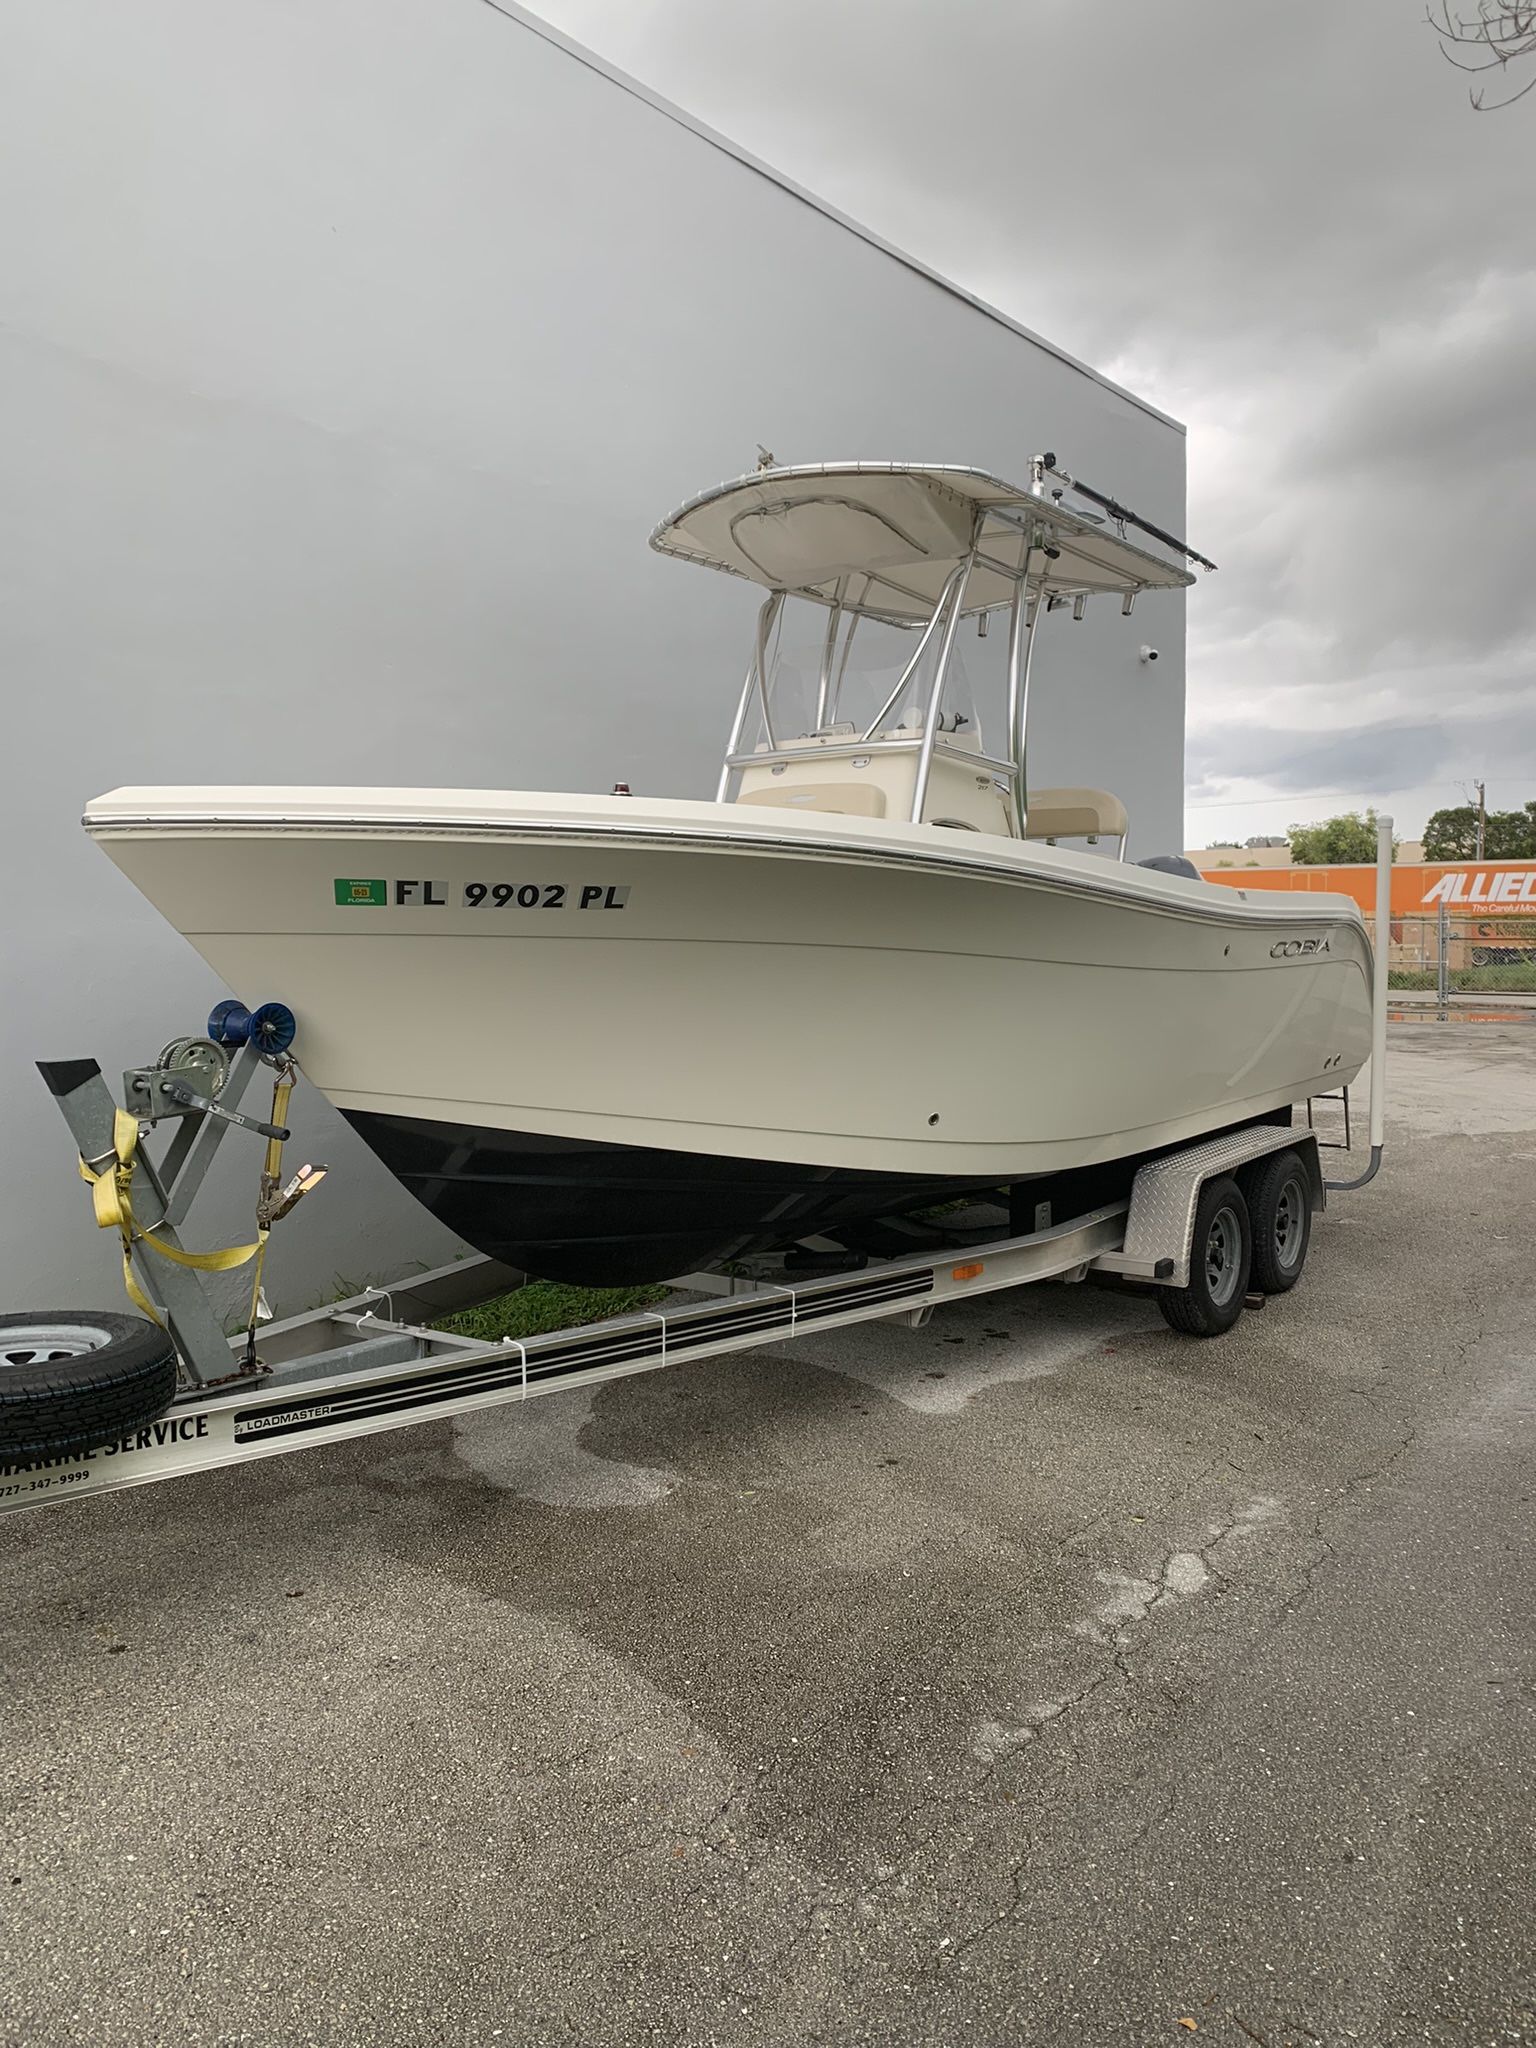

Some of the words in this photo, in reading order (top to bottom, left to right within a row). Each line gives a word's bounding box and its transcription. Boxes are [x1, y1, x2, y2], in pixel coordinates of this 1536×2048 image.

[396, 880, 446, 906] FL
[465, 883, 565, 908] 9902
[580, 886, 625, 909] PL
[1472, 903, 1488, 913] The
[1489, 903, 1520, 913] Careful
[1270, 938, 1330, 959] COBIA
[247, 1406, 330, 1430] LOADMASTER
[104, 1414, 209, 1457] SERVICE
[0, 1470, 90, 1498] 727-347-9999
